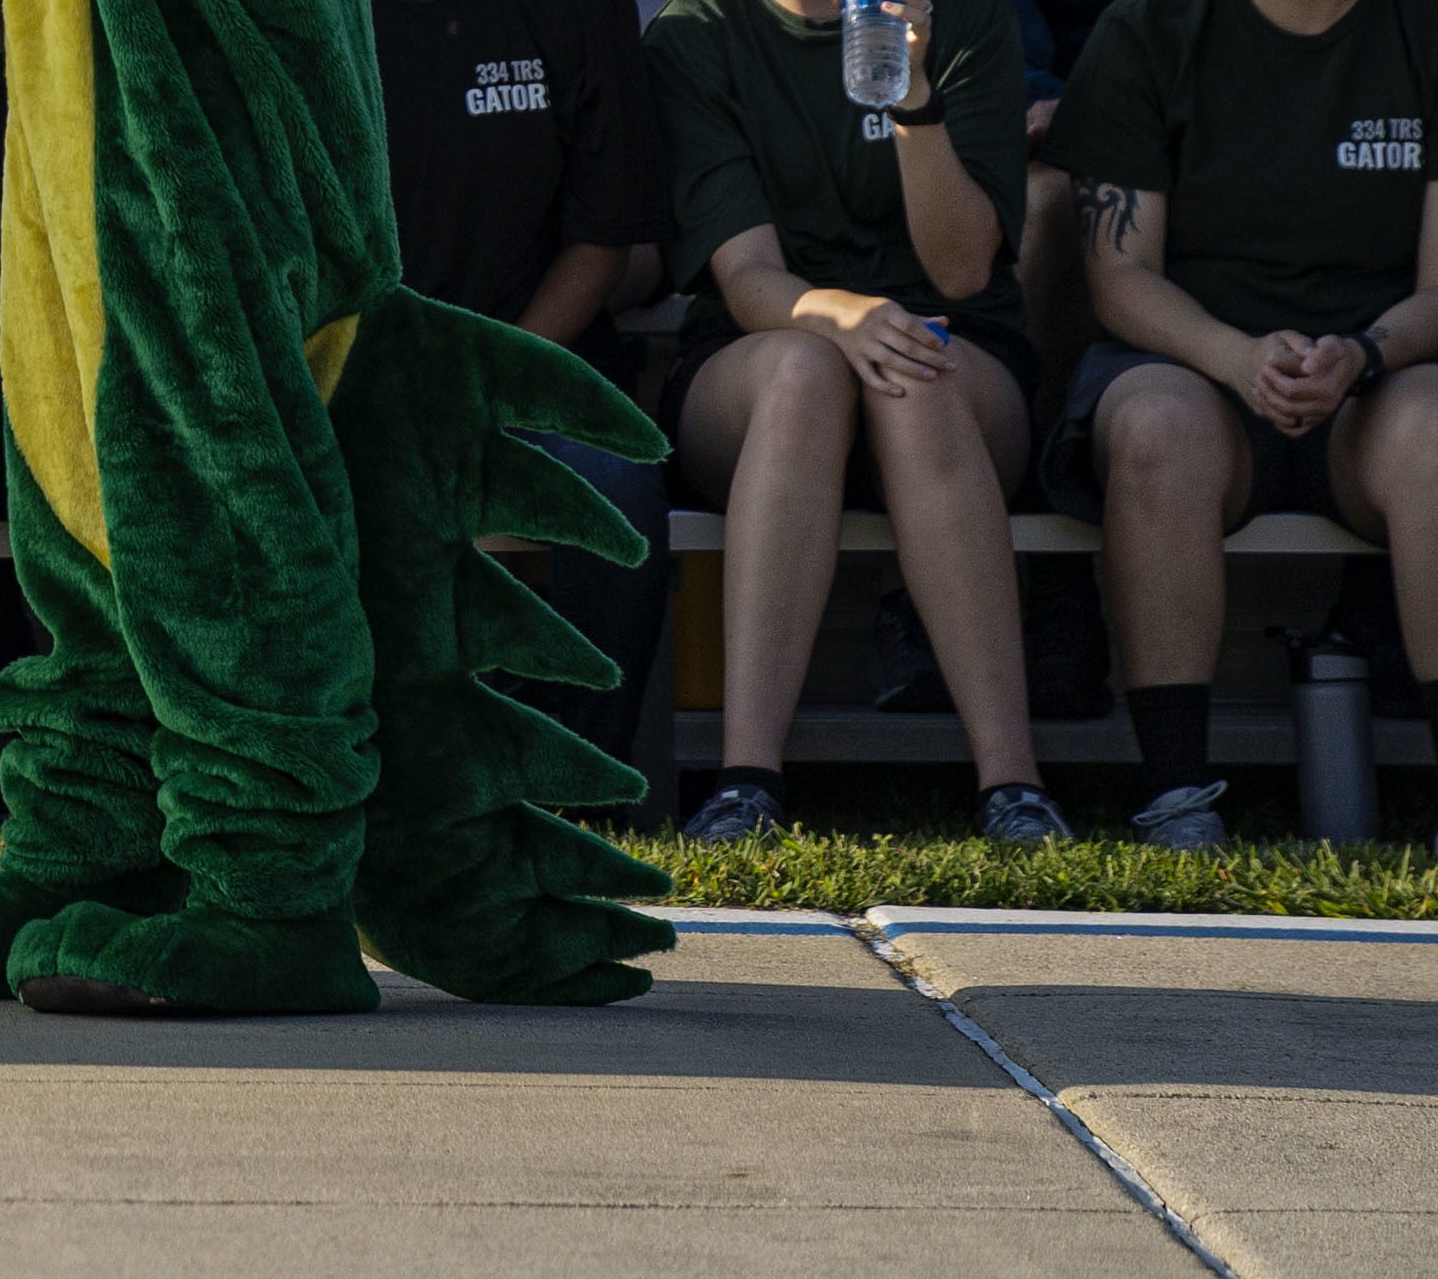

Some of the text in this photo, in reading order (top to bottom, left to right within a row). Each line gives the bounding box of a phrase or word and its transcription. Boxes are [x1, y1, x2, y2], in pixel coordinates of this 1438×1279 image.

[474, 58, 545, 85] 334 TRS
[466, 82, 551, 116] GATOR
[1351, 117, 1424, 142] 334 TRS
